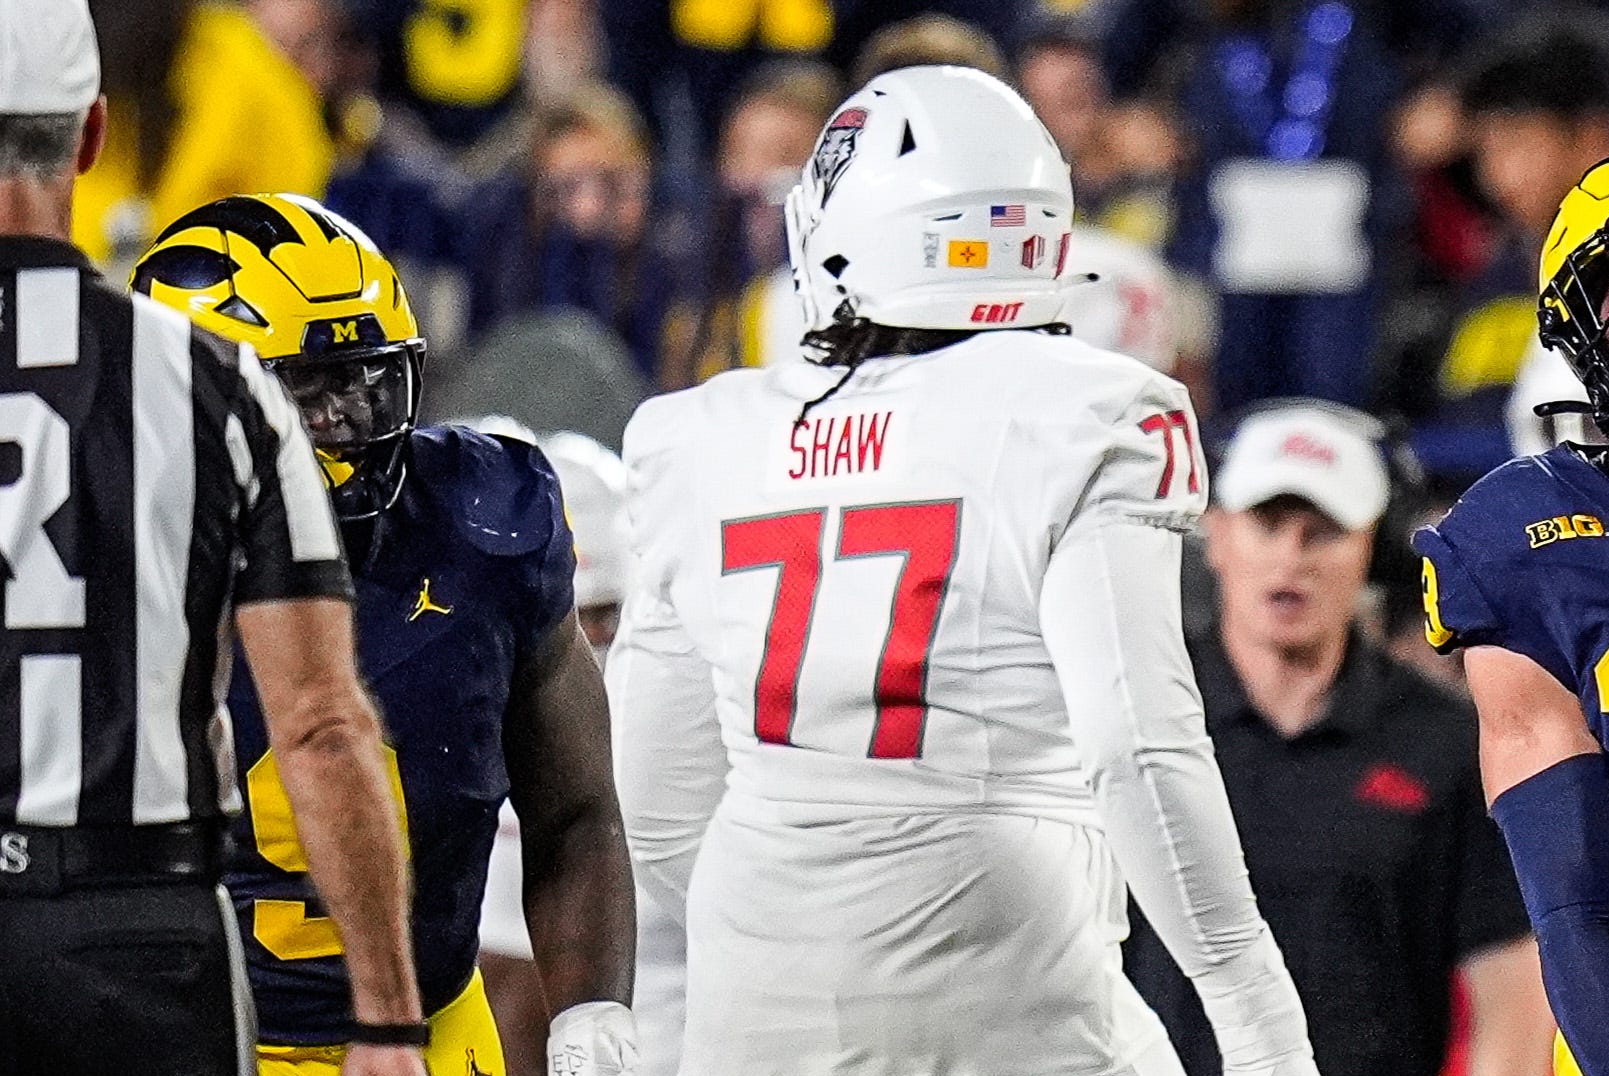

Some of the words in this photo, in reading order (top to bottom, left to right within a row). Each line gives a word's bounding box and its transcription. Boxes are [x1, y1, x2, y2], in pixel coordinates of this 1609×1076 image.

[331, 320, 359, 343] M
[788, 411, 893, 479] SHAW
[1136, 409, 1200, 500] 77
[720, 497, 964, 759] 77
